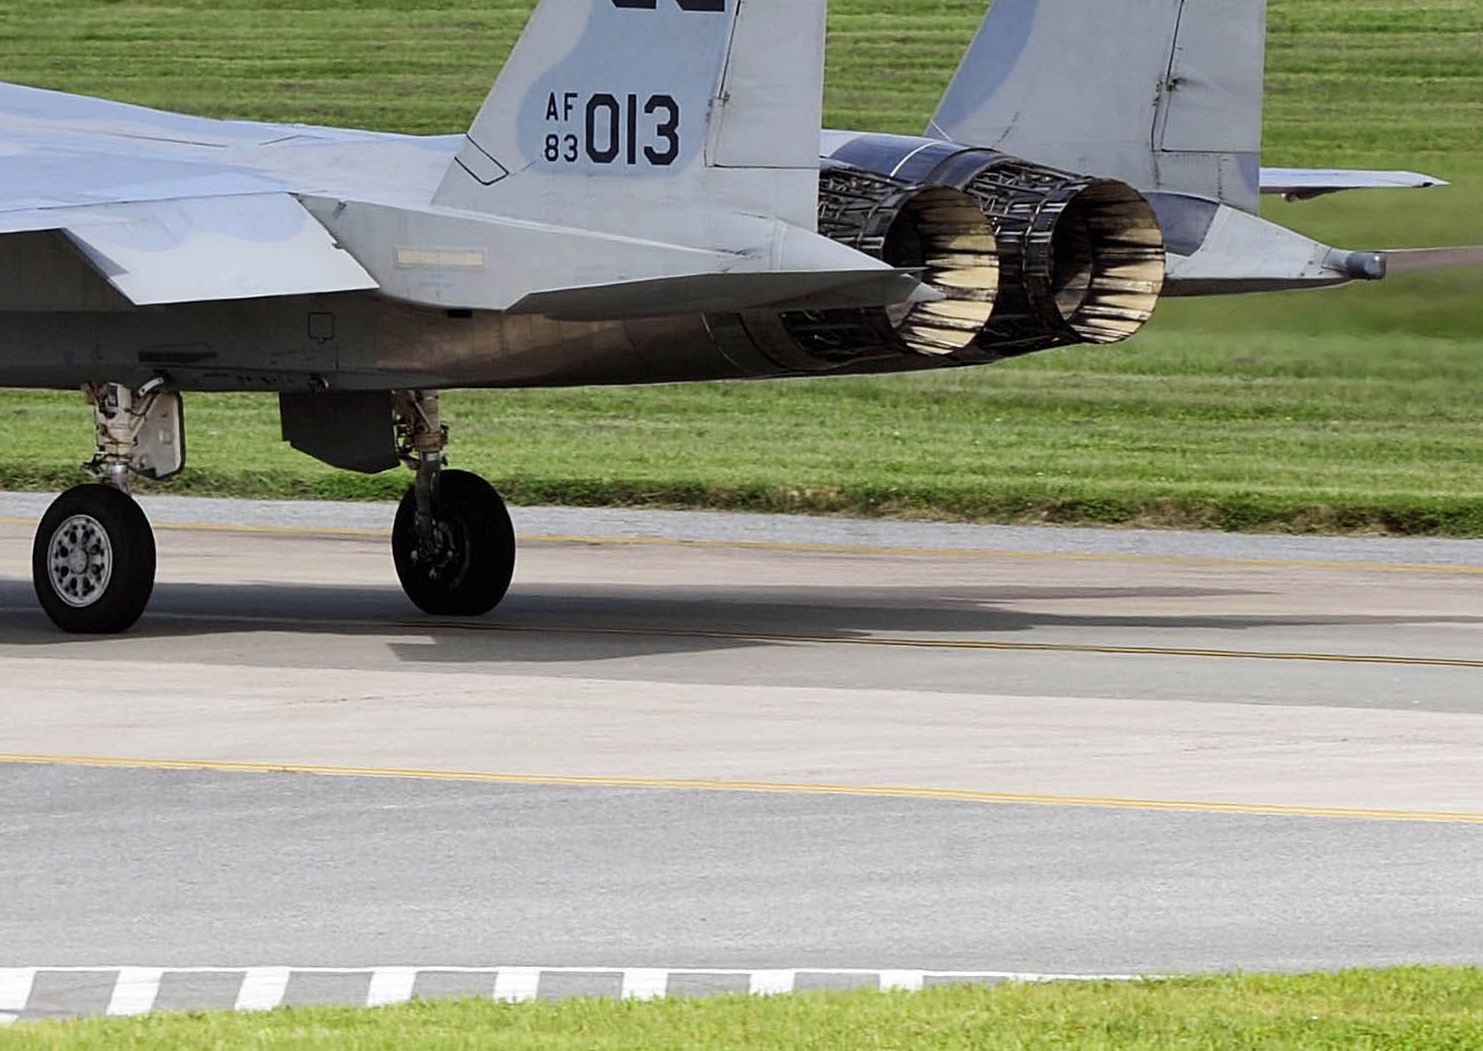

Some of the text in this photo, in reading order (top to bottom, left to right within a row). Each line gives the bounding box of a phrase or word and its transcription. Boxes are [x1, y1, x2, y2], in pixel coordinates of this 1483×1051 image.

[545, 92, 578, 121] AF
[585, 93, 680, 166] 013
[544, 134, 578, 162] 83
